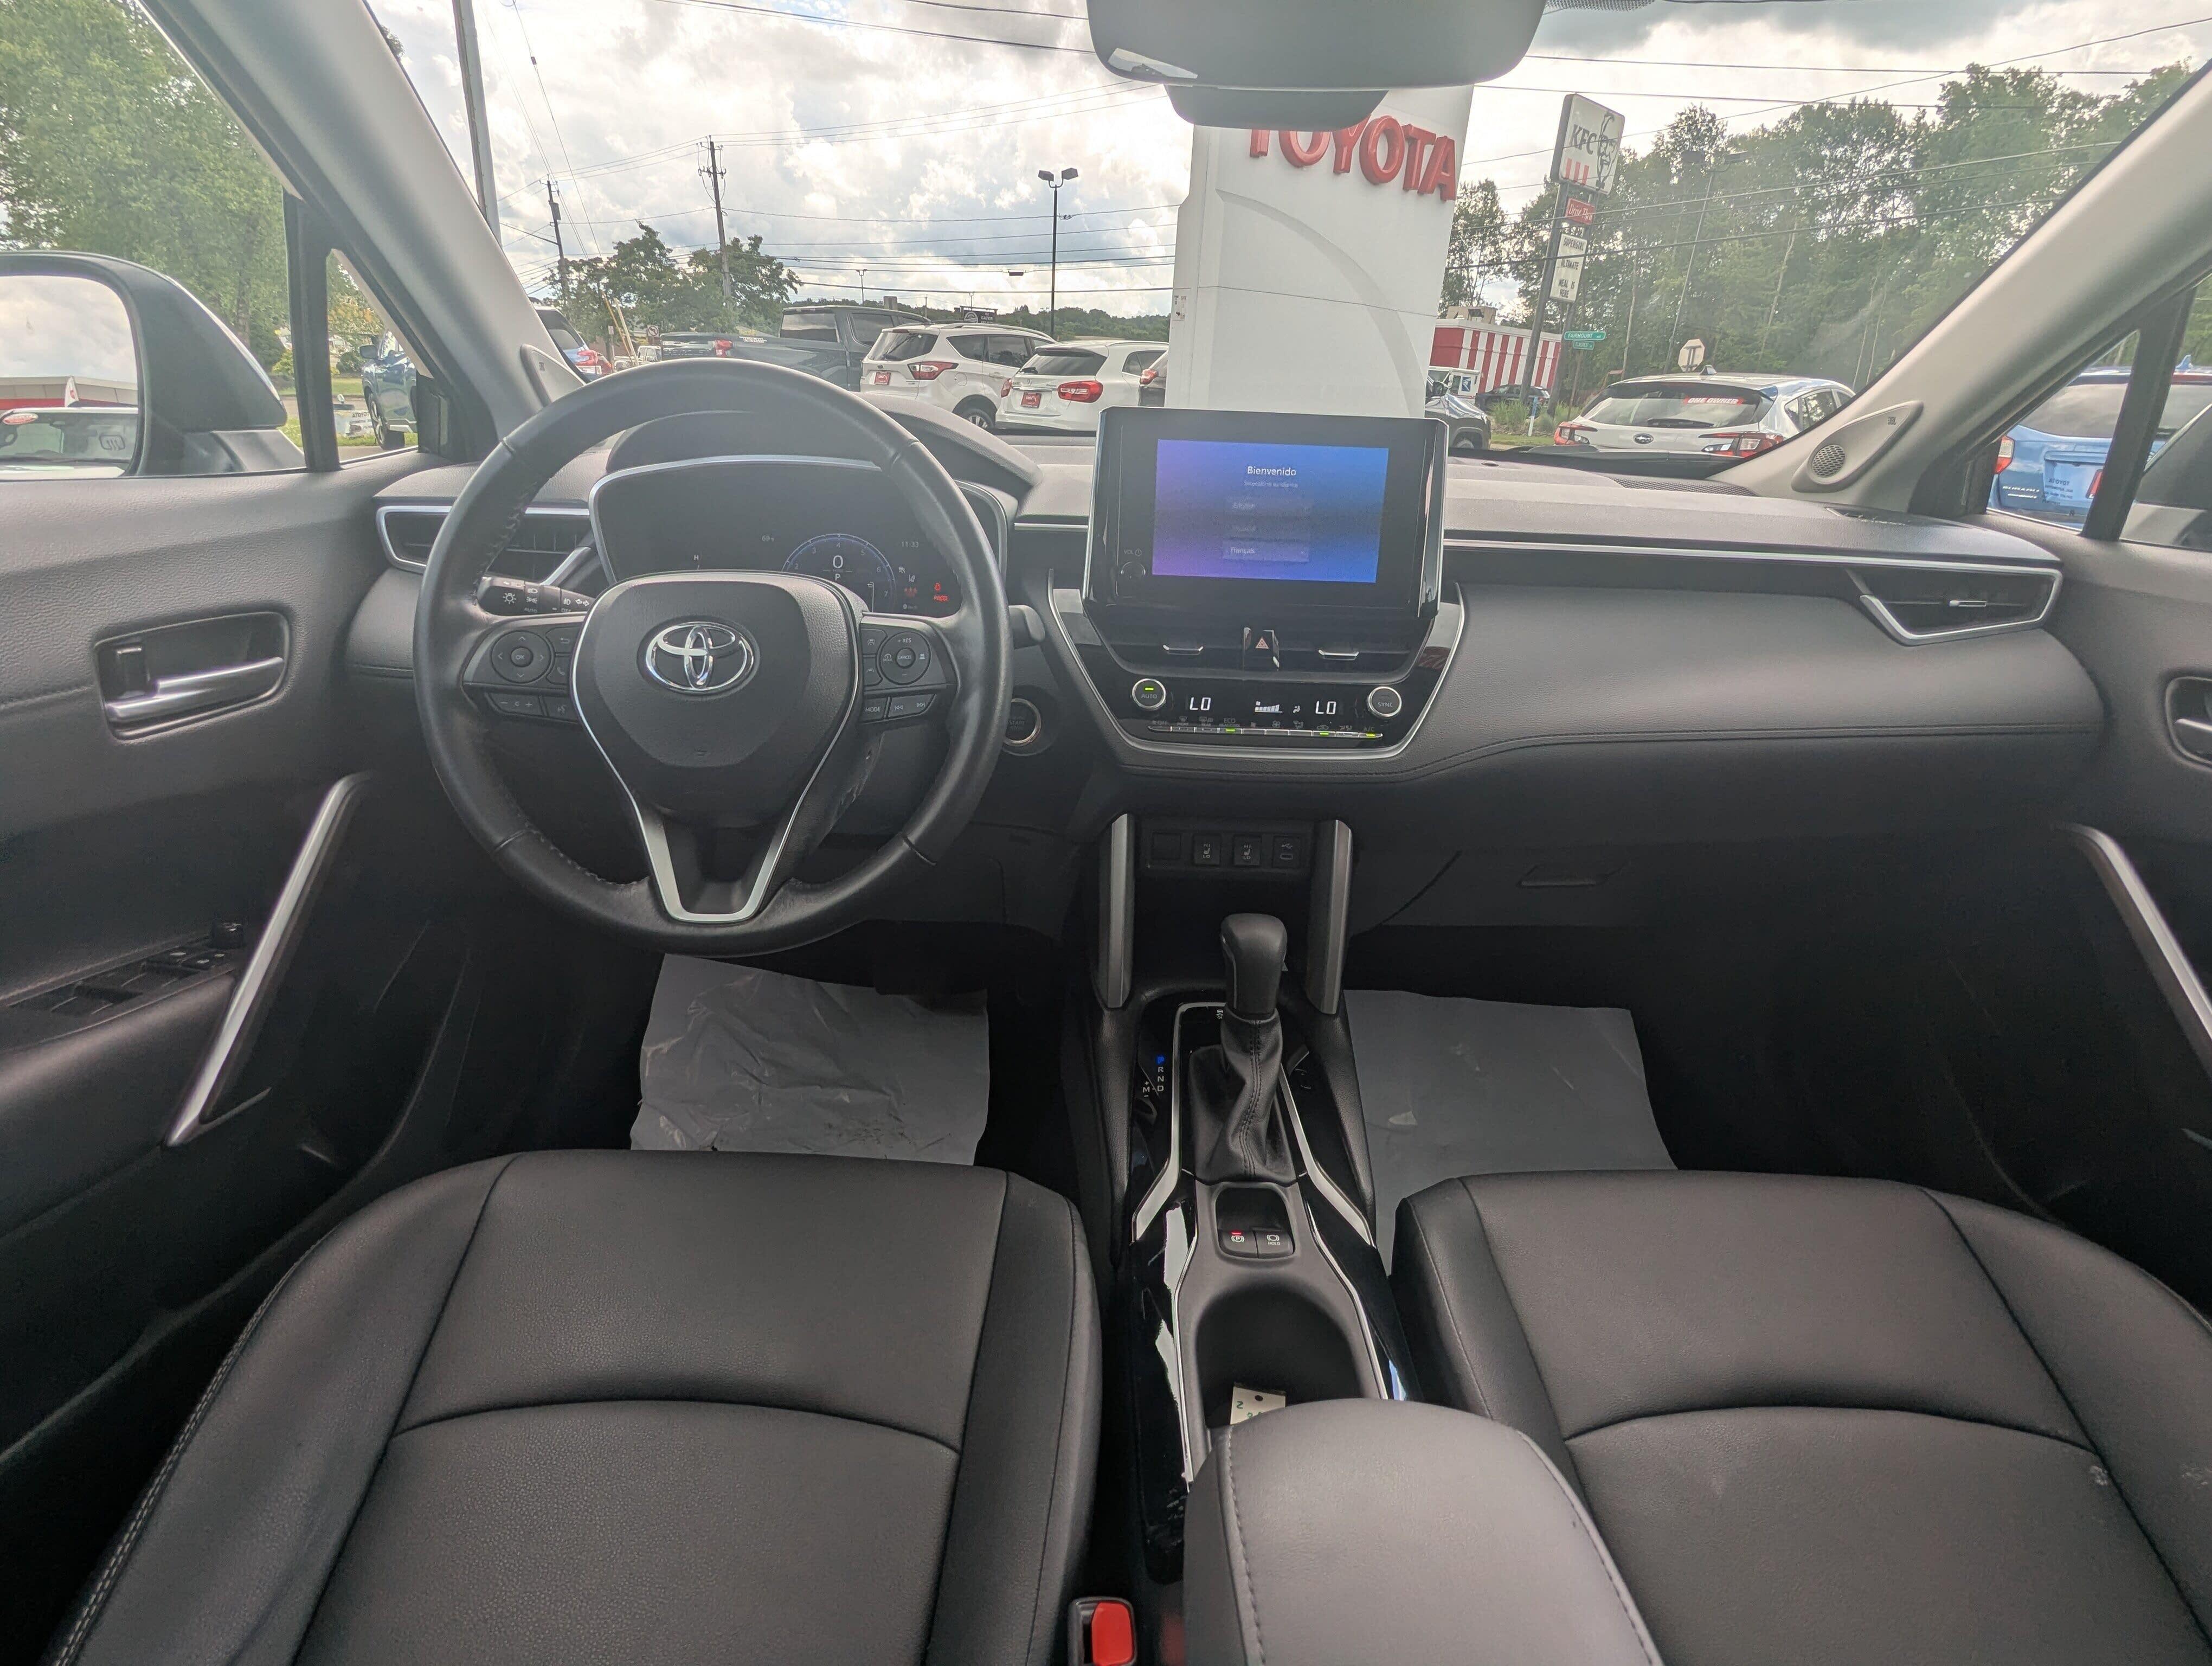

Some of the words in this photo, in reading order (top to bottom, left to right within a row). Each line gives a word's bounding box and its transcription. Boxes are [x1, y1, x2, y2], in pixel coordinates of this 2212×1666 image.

[1571, 124, 1597, 155] KFC
[1564, 238, 1584, 251] SUPERGIRL
[1561, 259, 1579, 271] ULTIMATE
[1558, 279, 1568, 288] MEAL
[1571, 281, 1575, 289] IS
[1559, 289, 1570, 298] HERE
[1247, 466, 1296, 476] Bienvenido
[1189, 697, 1211, 710] LO
[1315, 701, 1336, 714] LO
